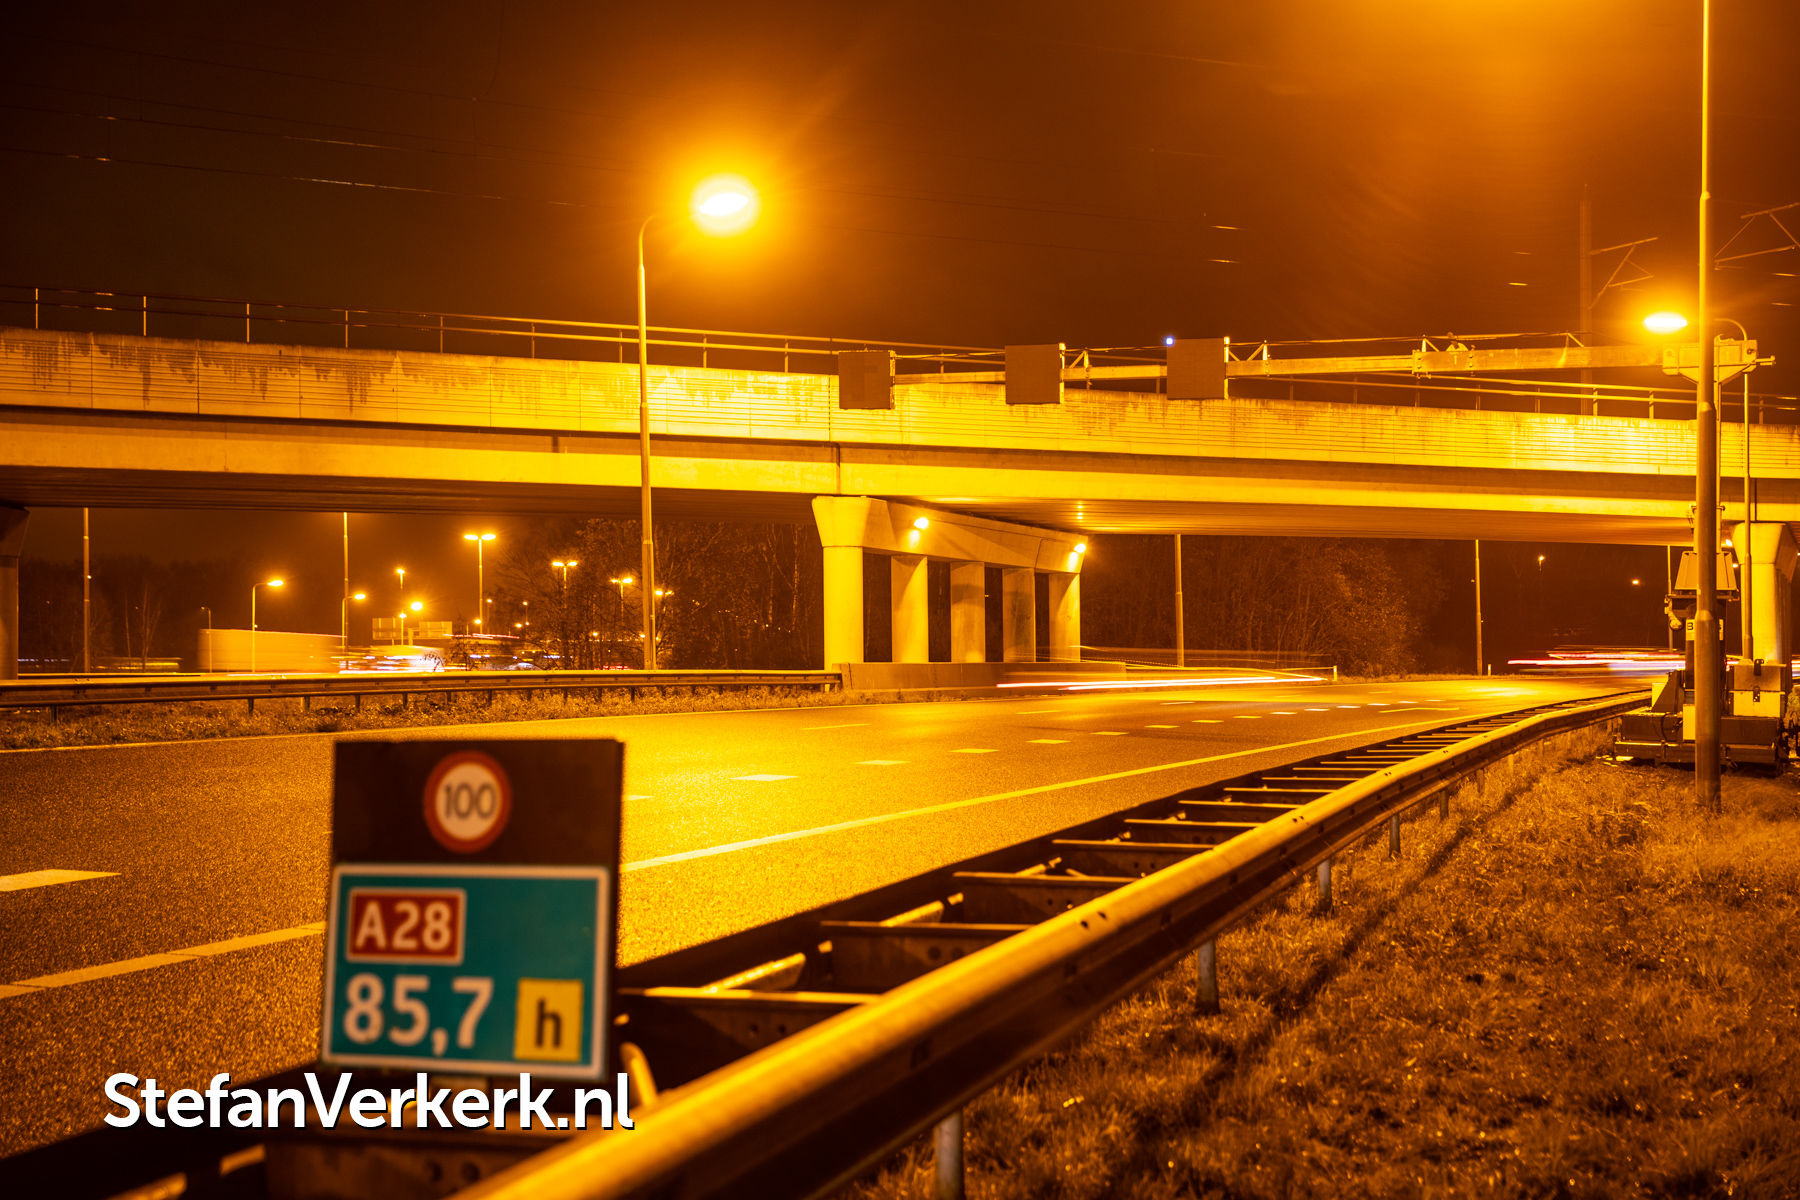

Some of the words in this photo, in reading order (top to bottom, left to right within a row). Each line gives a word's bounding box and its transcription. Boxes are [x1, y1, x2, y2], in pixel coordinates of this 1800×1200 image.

[443, 782, 499, 820] 100
[355, 901, 452, 951] A28
[343, 972, 494, 1056] 85,7
[534, 997, 562, 1049] h
